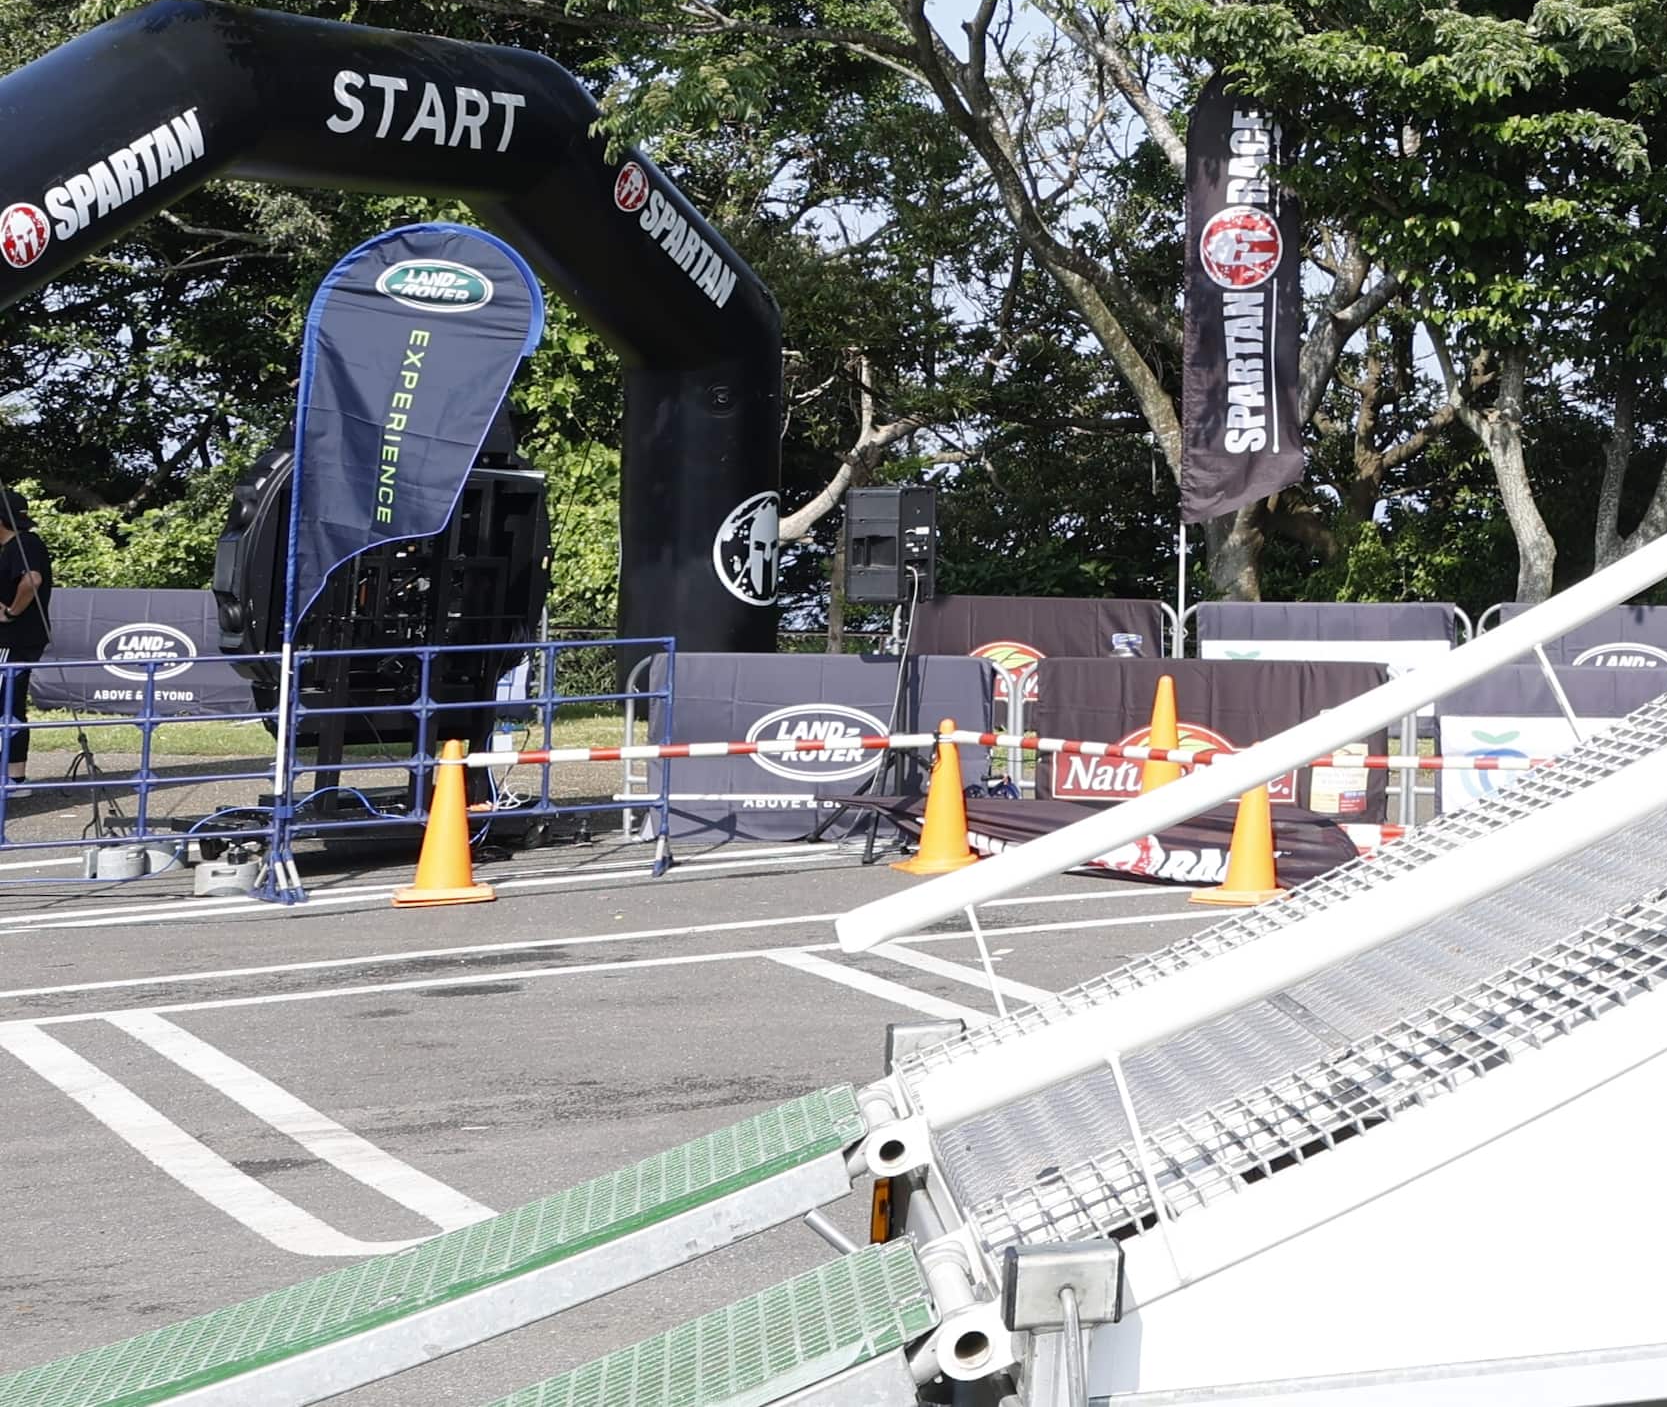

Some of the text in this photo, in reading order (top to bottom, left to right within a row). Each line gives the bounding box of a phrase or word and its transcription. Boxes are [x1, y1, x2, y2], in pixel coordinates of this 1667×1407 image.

[326, 69, 527, 153] START
[44, 108, 205, 241] SPARTAN
[639, 189, 737, 309] SPARTAN
[401, 283, 470, 302] ROVER
[404, 269, 457, 287] LAND
[1223, 109, 1273, 455] SPARTAN RACE
[376, 329, 430, 524] EXPERIENCE
[117, 636, 165, 651] LAND
[93, 689, 134, 701] ABOVE
[154, 690, 194, 702] EYOND
[777, 720, 846, 741] LAND
